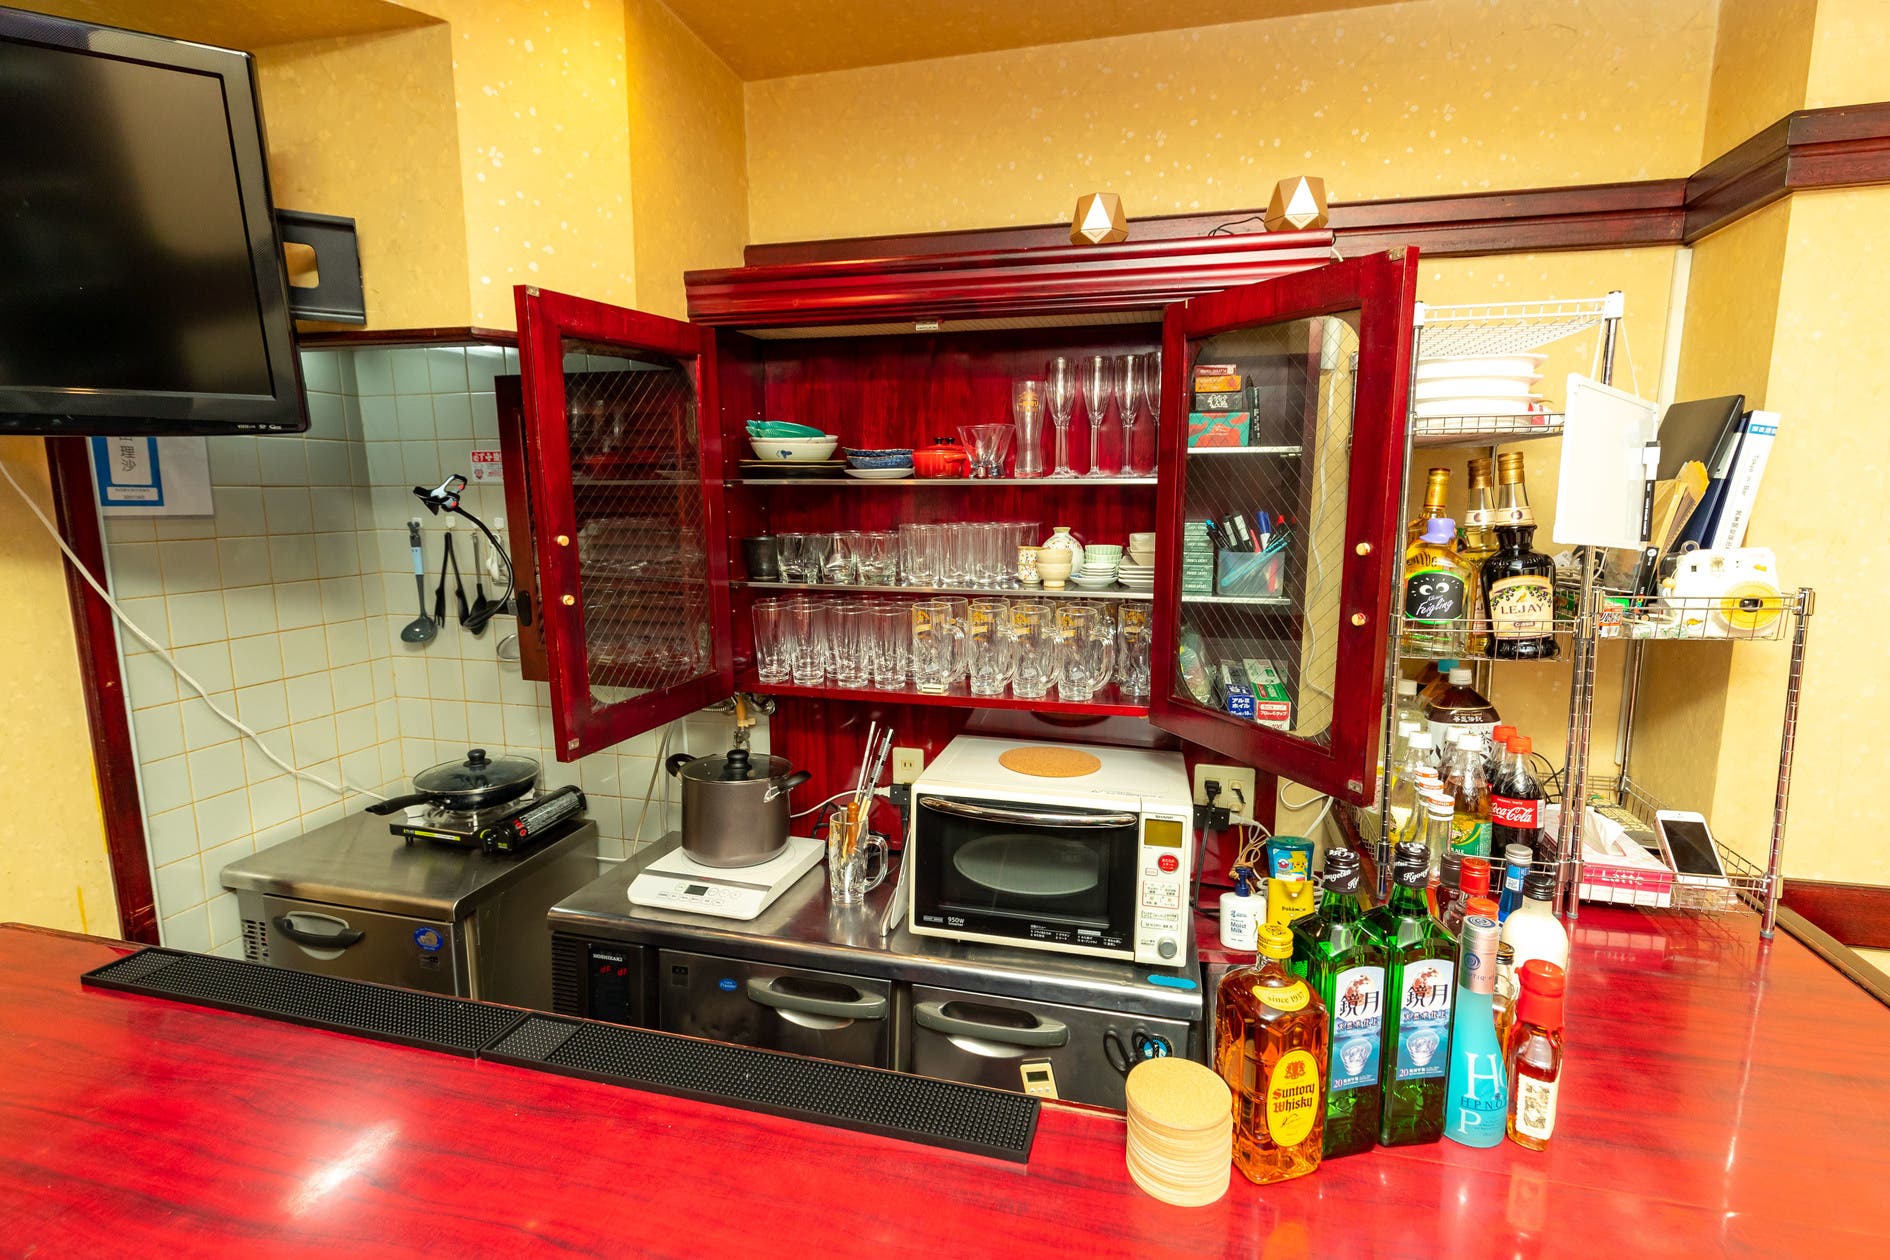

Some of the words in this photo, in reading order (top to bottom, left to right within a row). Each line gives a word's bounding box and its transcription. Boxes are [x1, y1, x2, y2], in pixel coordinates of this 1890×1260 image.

[1415, 598, 1455, 617] Feigling
[1500, 603, 1545, 615] LEJAY
[1230, 920, 1247, 929] Moist
[1339, 991, 1380, 1018] 鏡月
[1406, 984, 1449, 1008] 鏡月
[1399, 1068, 1409, 1078] 20
[1272, 1082, 1316, 1101] Suntory
[1272, 1096, 1314, 1114] Whisky
